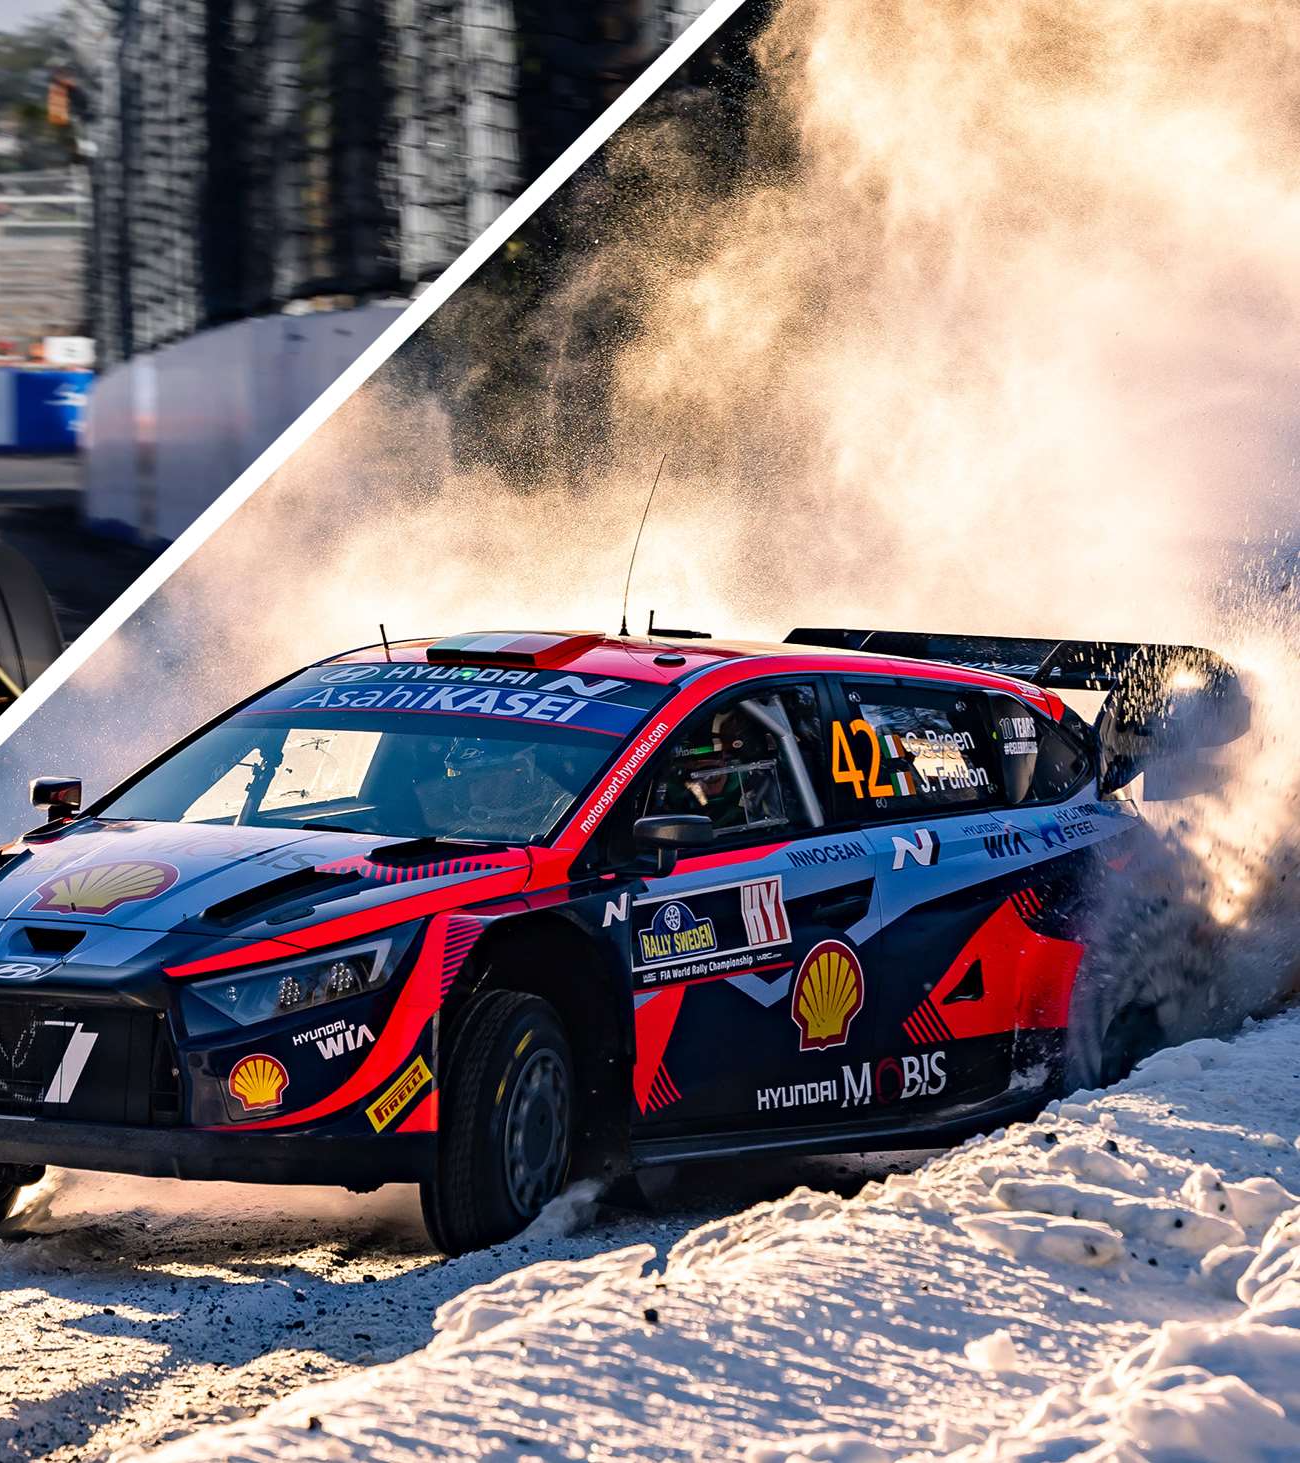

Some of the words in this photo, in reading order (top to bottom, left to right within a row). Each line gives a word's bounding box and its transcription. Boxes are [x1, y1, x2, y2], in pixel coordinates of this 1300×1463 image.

[383, 666, 539, 686] HYUNDAI
[1011, 717, 1036, 737] YEARS
[831, 719, 894, 798] 42
[580, 722, 669, 834] motorsport.hyundai.com
[921, 768, 937, 793] J.
[937, 766, 990, 791] Fulton
[1053, 803, 1100, 824] HYUNDAI
[961, 822, 1004, 836] HYUNDAI
[1063, 820, 1100, 839] STEEL
[786, 841, 868, 867] INNOCEAN
[642, 931, 672, 959] RALLY
[674, 923, 714, 952] SWEDEN
[660, 970, 671, 981] FIA
[672, 966, 691, 979] World
[692, 963, 708, 976] Rally
[709, 954, 753, 973] Championship
[292, 1019, 347, 1046] HYUNDAI
[372, 1063, 424, 1125] PIRELLI
[757, 1079, 838, 1111] HYUNDAI
[841, 1051, 948, 1109] MOBIS
